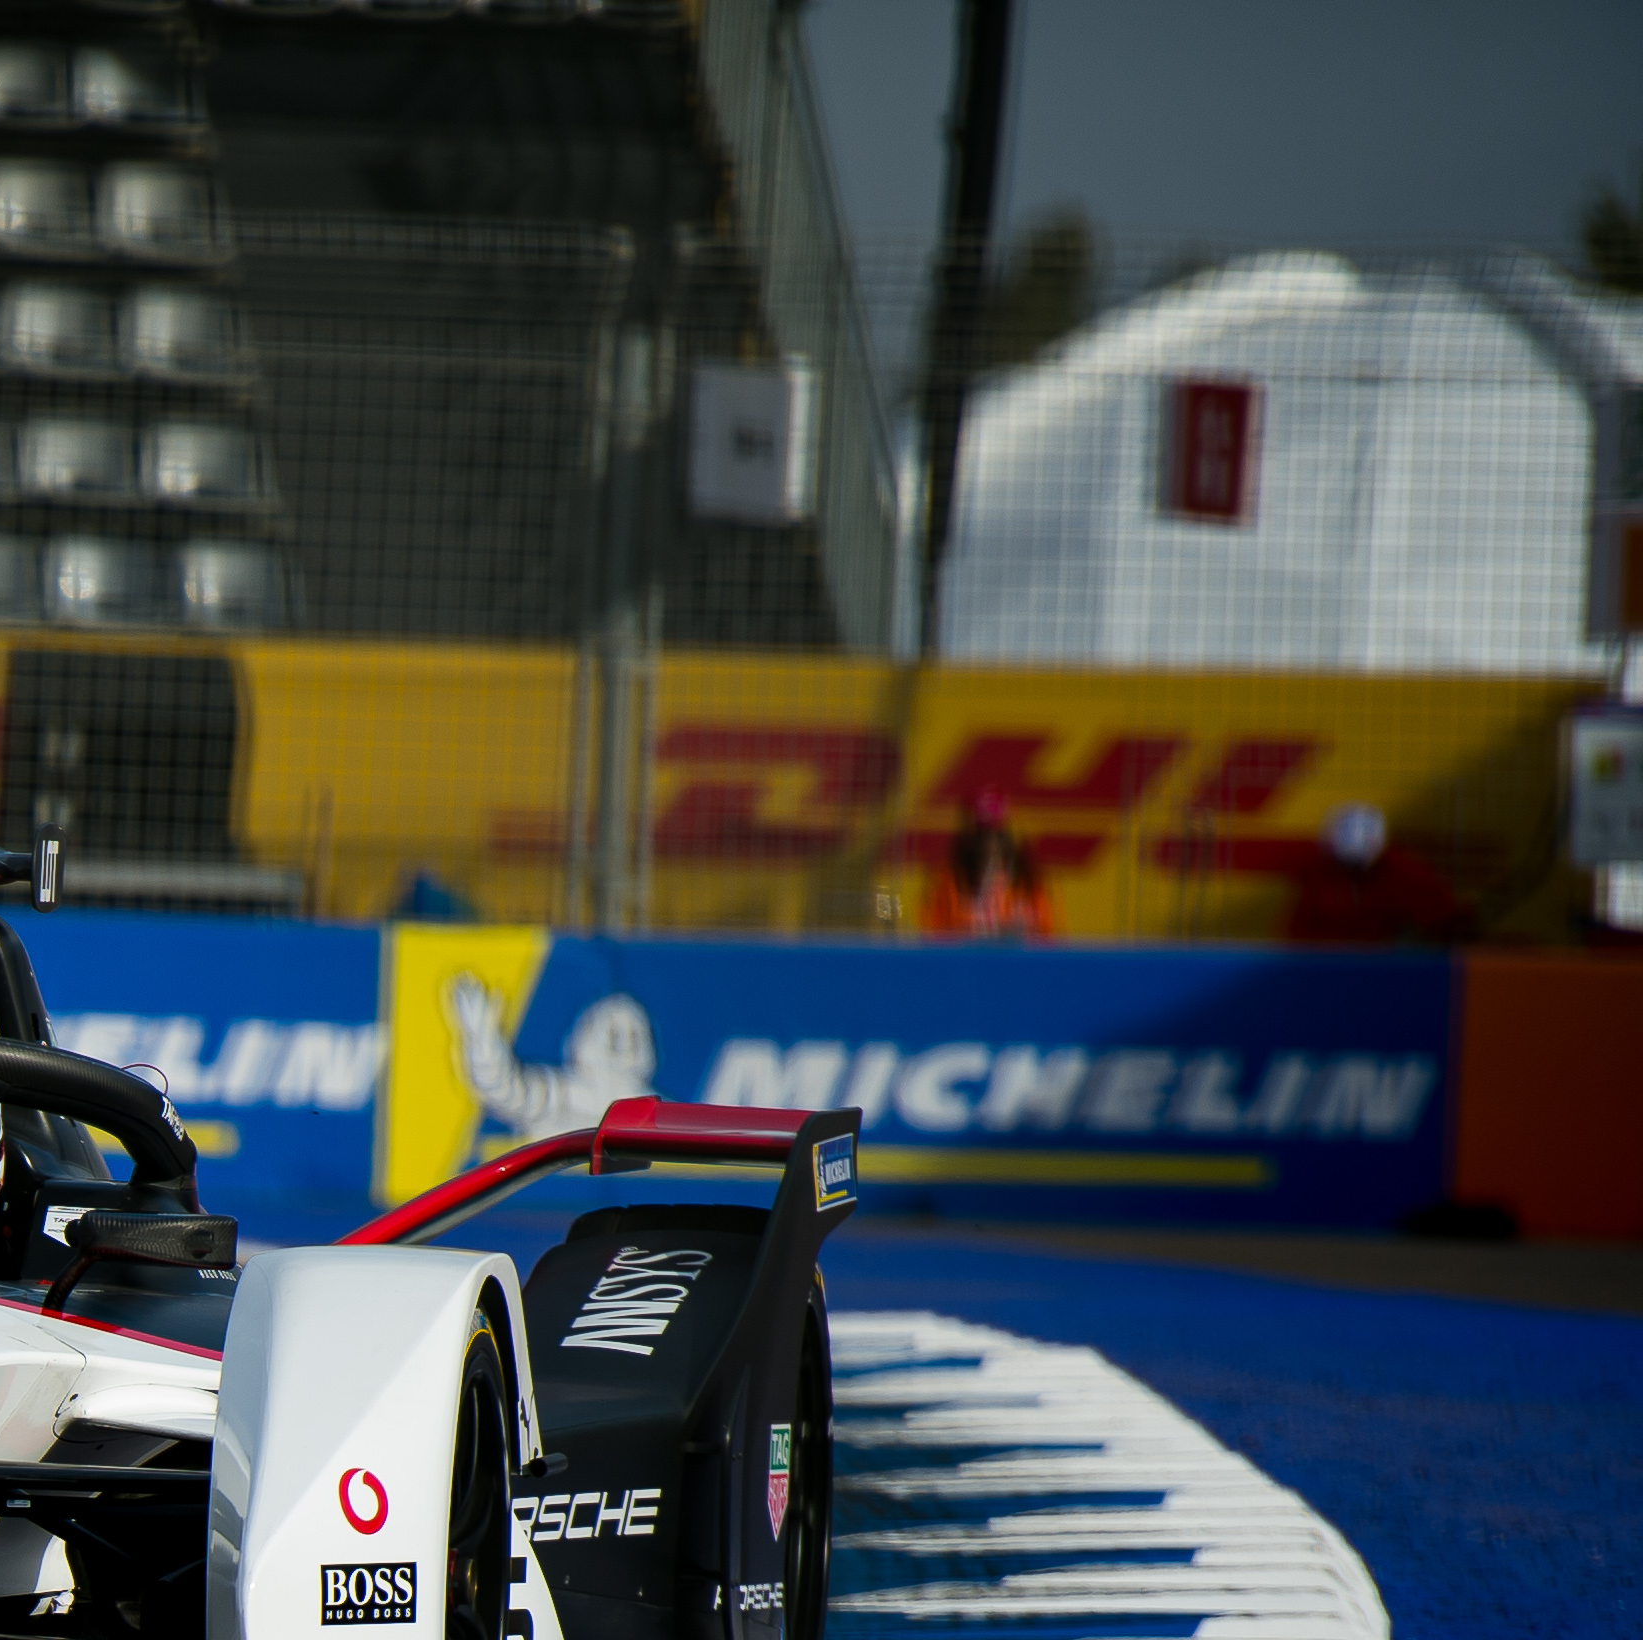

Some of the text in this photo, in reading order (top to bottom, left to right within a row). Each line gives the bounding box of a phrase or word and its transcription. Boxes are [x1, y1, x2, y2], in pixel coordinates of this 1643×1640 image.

[701, 1038, 1437, 1139] MICHELIN
[561, 1249, 713, 1356] ANSYS
[771, 1432, 789, 1466] TAG
[512, 1488, 662, 1542] RSCHE
[325, 1567, 414, 1606] BOSS
[326, 1608, 412, 1620] HUGO BOSS
